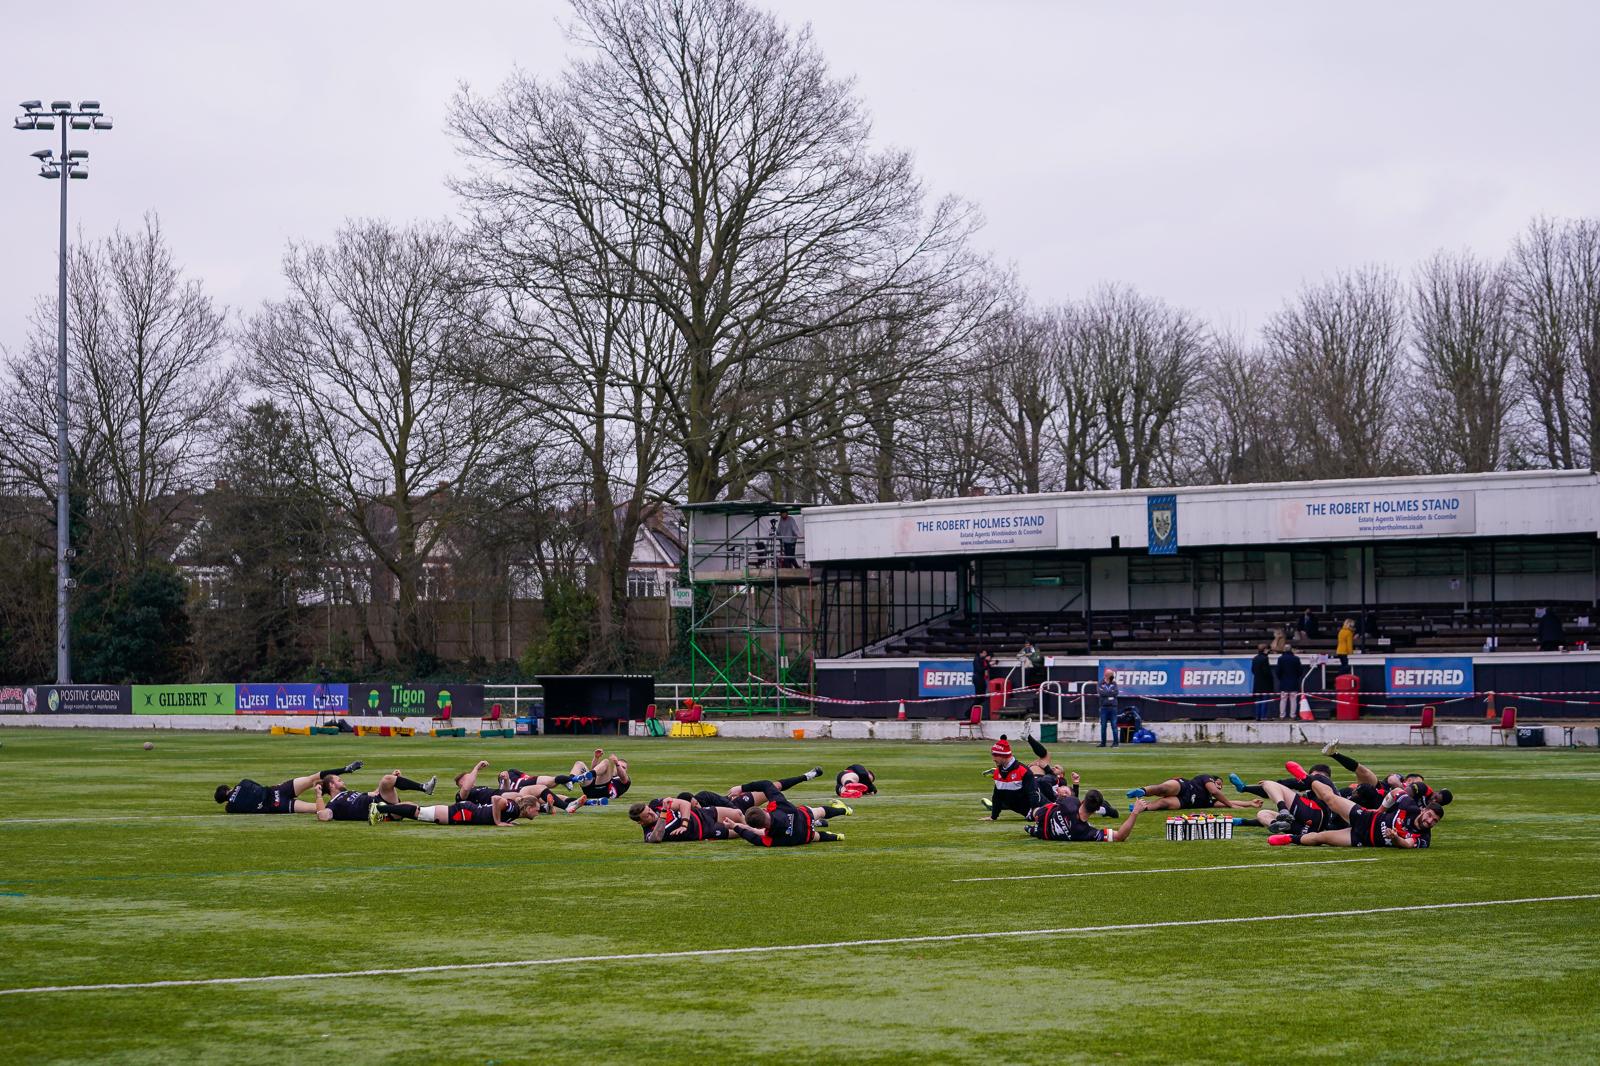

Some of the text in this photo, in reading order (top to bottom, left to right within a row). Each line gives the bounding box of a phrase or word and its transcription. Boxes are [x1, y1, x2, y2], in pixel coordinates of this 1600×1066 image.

[1306, 498, 1460, 516] THE ROBERT HOLMES STAND
[917, 515, 1045, 532] THE ROBERT HOLMES STAND
[1375, 515, 1394, 523] Agents
[1434, 512, 1457, 520] Coombe
[926, 671, 974, 686] BETFRE
[1113, 670, 1168, 686] ETFRED
[1183, 670, 1246, 685] BETFRED
[1394, 669, 1465, 685] BETFRED
[60, 689, 120, 701] POSITIVE GARDEN
[159, 692, 208, 707] GILBERT
[250, 695, 269, 706] ZEST
[288, 695, 306, 706] ZEST
[391, 685, 425, 707] Tigon
